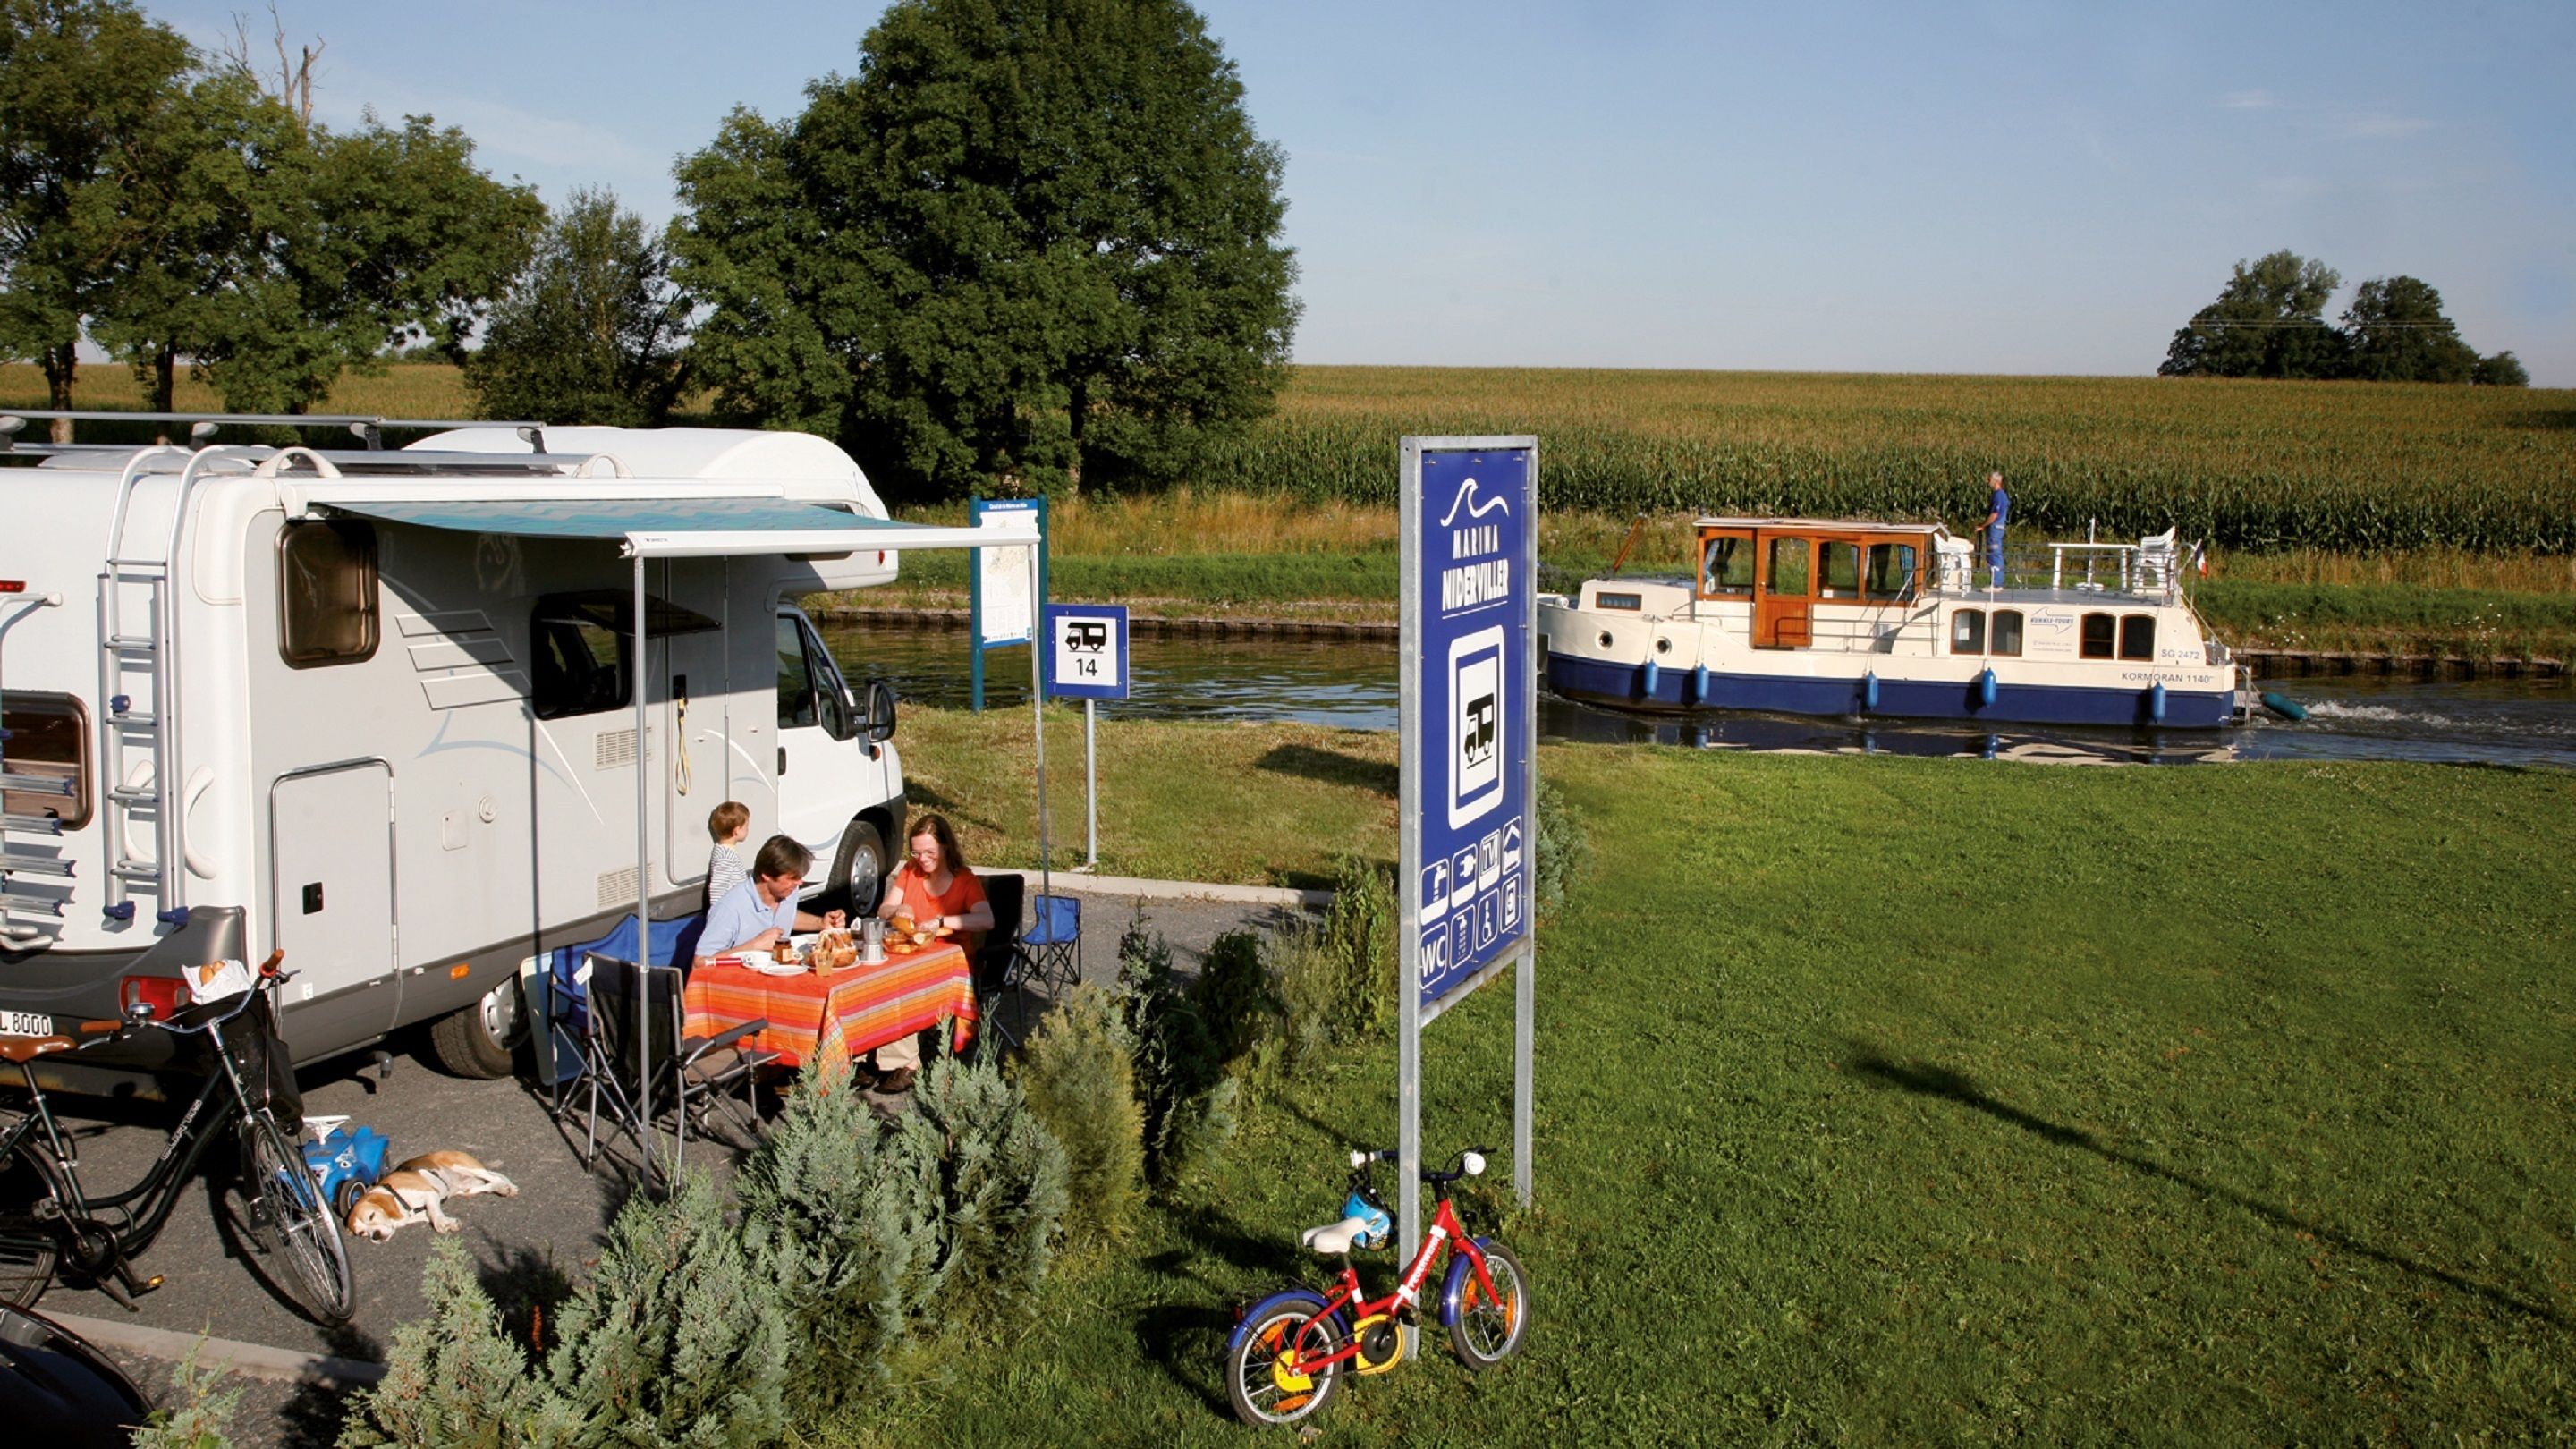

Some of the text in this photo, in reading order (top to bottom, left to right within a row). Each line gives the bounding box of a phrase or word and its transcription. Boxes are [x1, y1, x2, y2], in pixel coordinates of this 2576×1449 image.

[1453, 525, 1498, 560] MARINA
[1442, 558, 1509, 611] NIDERVILLER
[2161, 649, 2200, 660] SG 2472
[1076, 658, 1098, 676] 14
[2122, 672, 2211, 684] KORMORAN 1140
[1421, 935, 1446, 978] WC
[13, 1013, 50, 1036] 8000
